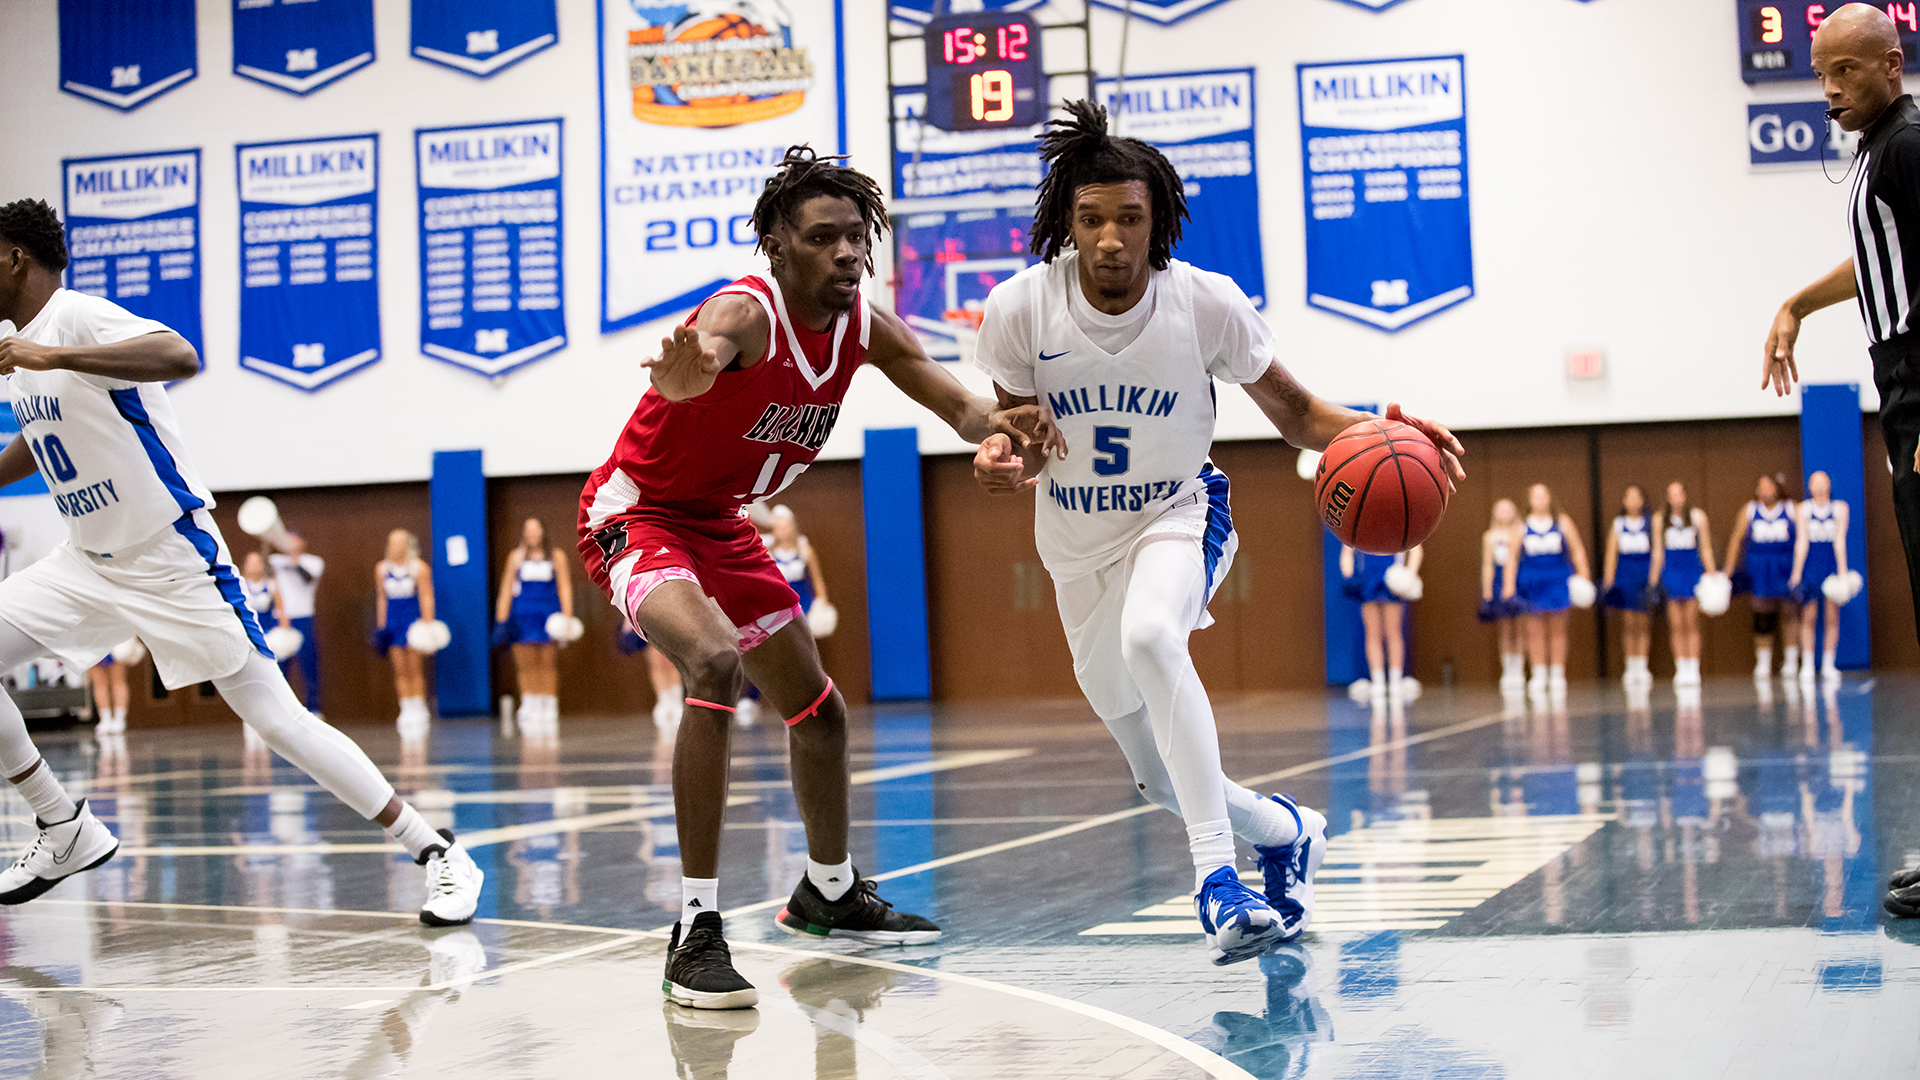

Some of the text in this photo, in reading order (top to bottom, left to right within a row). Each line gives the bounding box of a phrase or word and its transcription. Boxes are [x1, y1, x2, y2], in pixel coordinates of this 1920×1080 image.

[1760, 6, 1784, 44] 3
[943, 22, 1030, 66] 15:12
[970, 69, 1014, 122] 19
[1108, 84, 1240, 118] MILLIKIN
[1312, 72, 1450, 102] MILLIKIN
[428, 134, 550, 163] MILLIKIN
[1749, 113, 1815, 153] Go
[75, 164, 189, 195] MILLIKIN
[249, 150, 366, 179] MILLIKIN
[633, 147, 786, 177] NATIONA
[645, 214, 757, 251] 200
[13, 394, 63, 430] ILLIKIN
[1047, 384, 1180, 421] MILLIKIN
[32, 432, 79, 485] 10
[1091, 424, 1132, 478] 5
